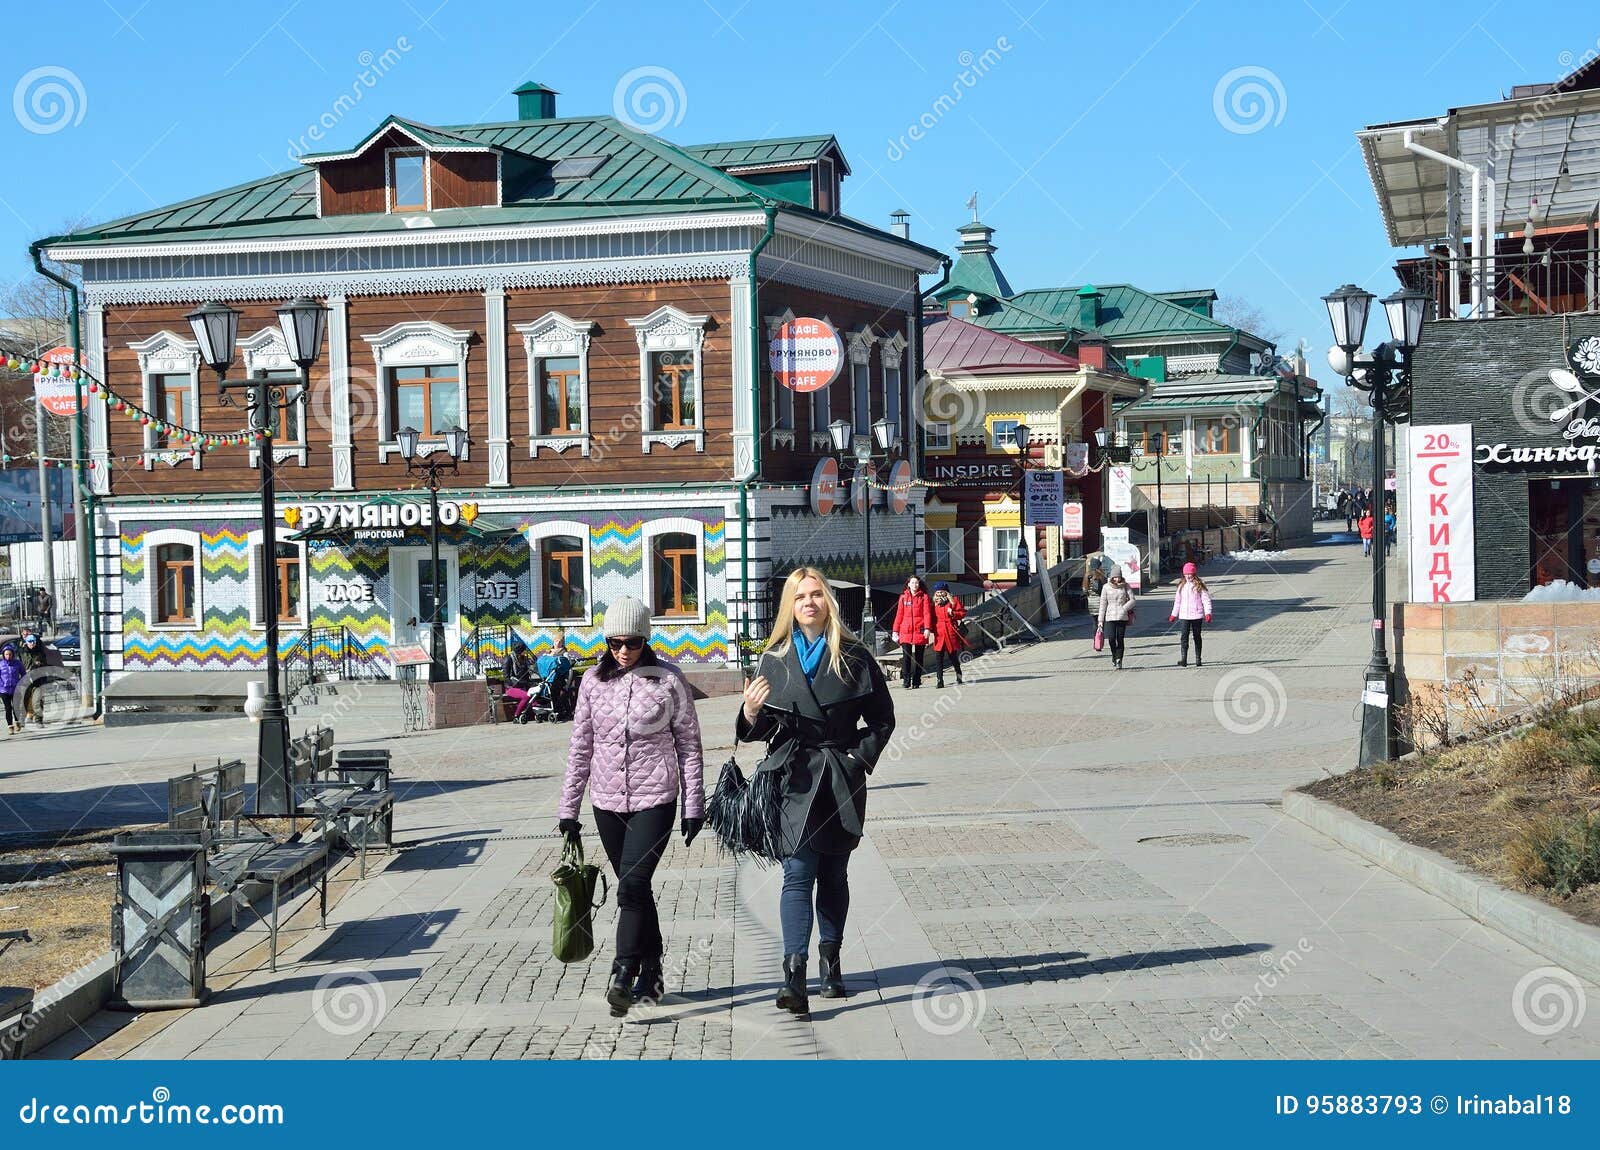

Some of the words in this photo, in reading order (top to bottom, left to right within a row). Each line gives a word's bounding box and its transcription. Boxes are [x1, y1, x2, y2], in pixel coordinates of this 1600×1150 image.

[789, 324, 819, 335] КАФЕ
[776, 348, 832, 358] РУМЯНОВО
[789, 376, 817, 386] CAFE
[1424, 434, 1459, 450] 20%
[1473, 443, 1600, 464] Хинка
[935, 464, 1013, 478] INSPIRE
[302, 502, 461, 529] РУМЯНОВО
[354, 530, 405, 539] ПИРОГОВАЯ
[325, 585, 374, 601] КАФЕ
[476, 583, 518, 599] CAFE
